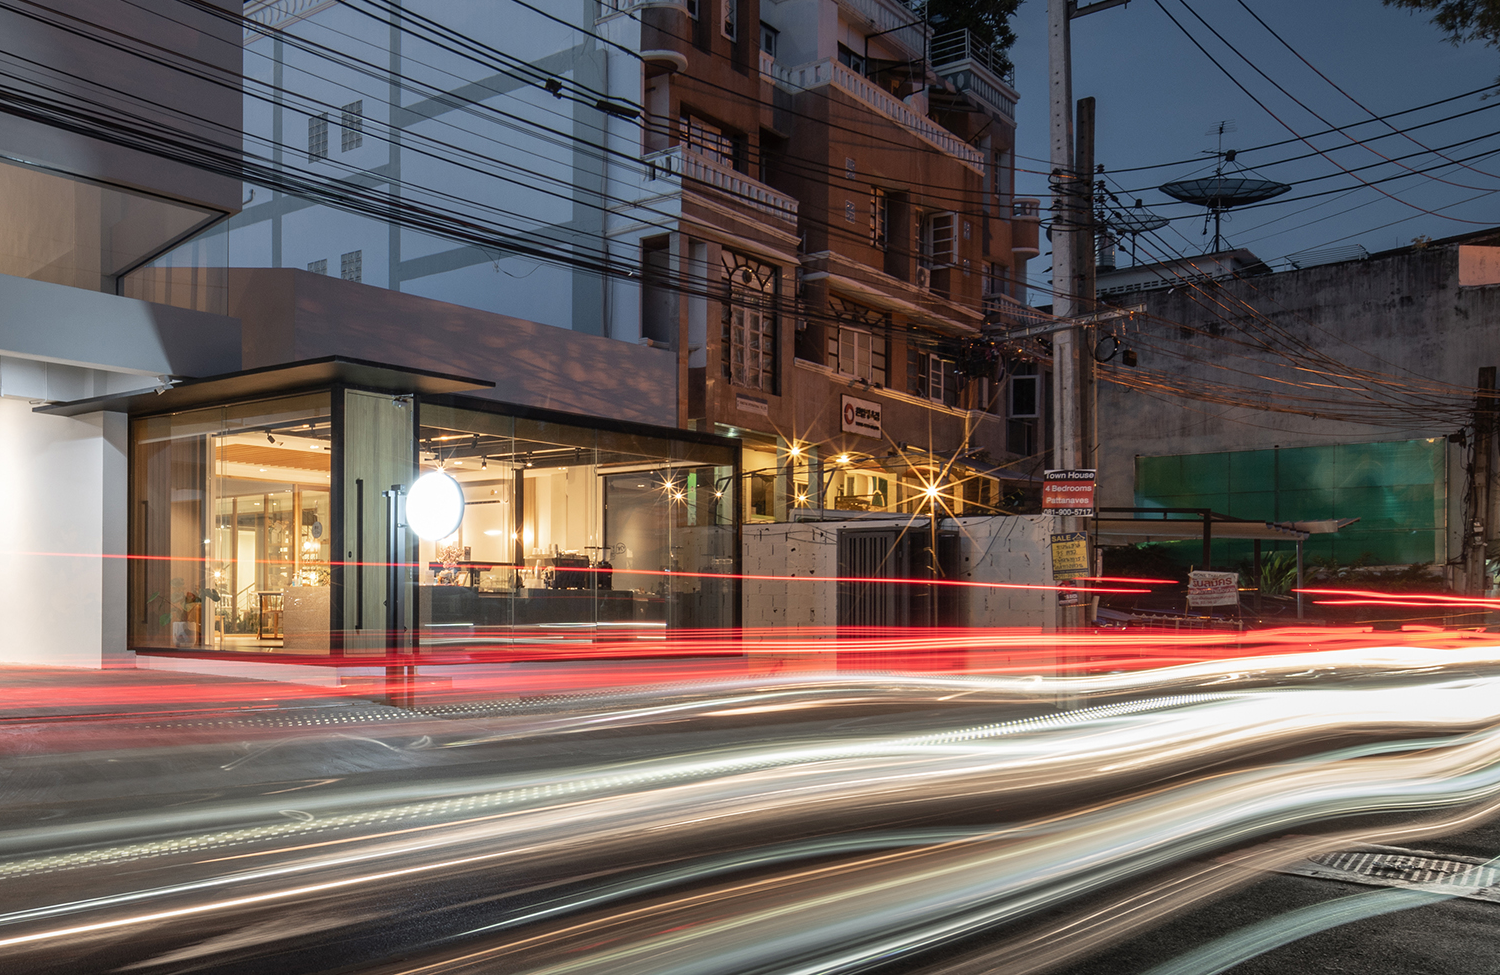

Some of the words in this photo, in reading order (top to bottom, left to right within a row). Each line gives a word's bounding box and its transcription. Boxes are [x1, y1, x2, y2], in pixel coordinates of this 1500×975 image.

[1051, 534, 1071, 542] SALE
[1192, 577, 1232, 587] รับสมัคร
